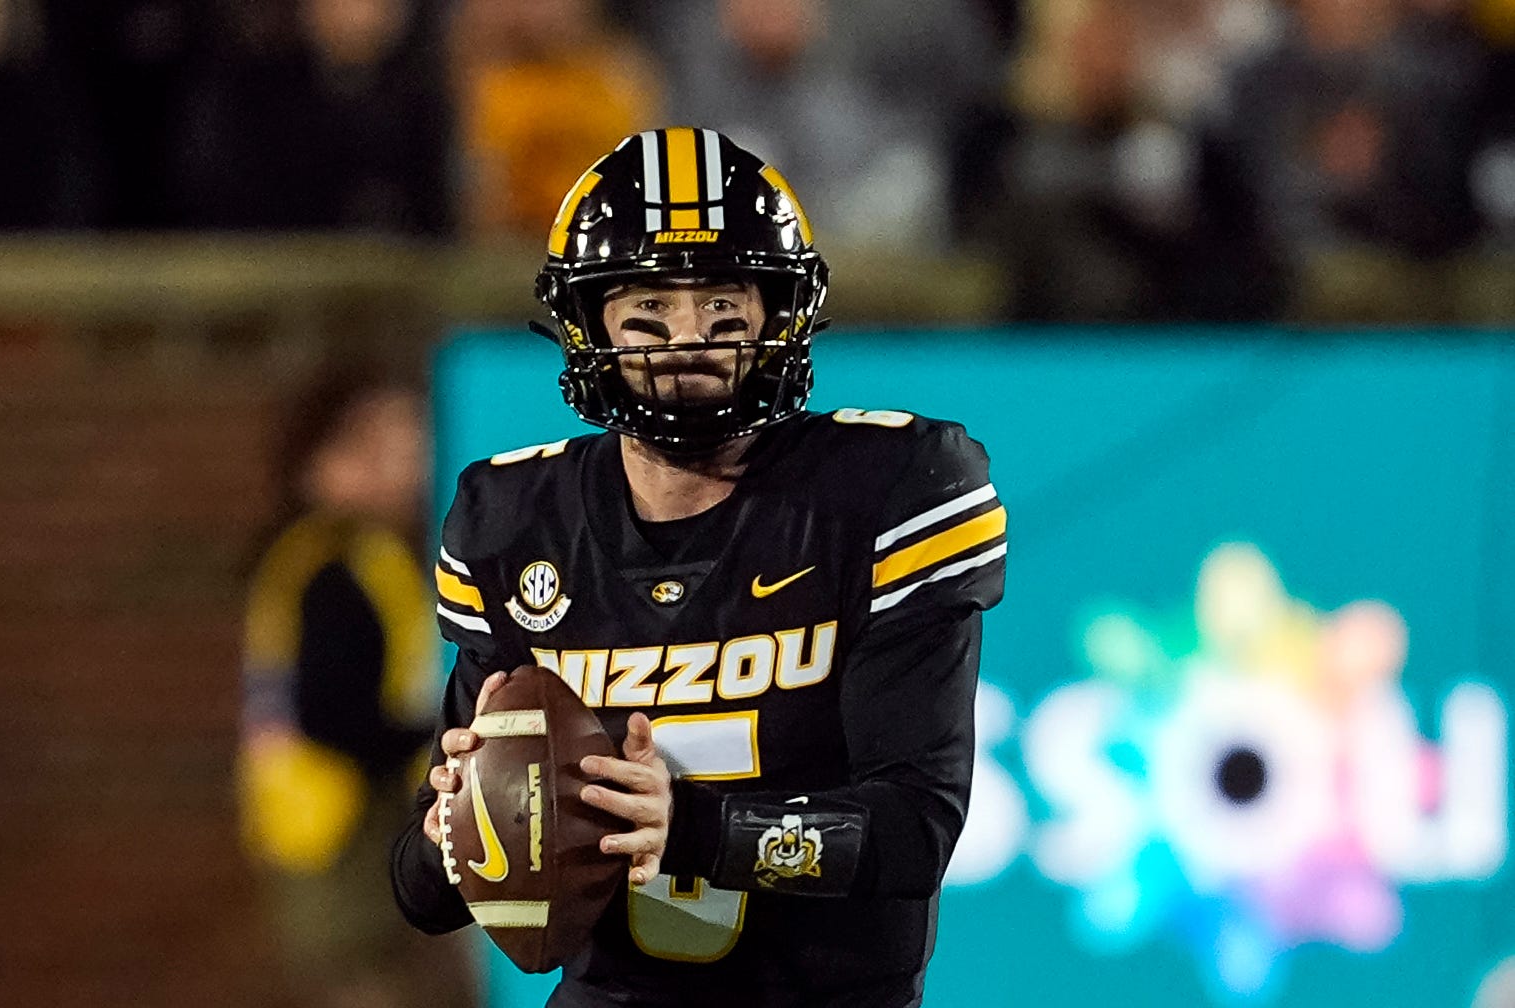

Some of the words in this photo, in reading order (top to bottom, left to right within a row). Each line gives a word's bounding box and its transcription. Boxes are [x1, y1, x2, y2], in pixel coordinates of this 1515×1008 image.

[654, 230, 719, 244] MIZZOU
[522, 564, 557, 607] SEC
[514, 608, 563, 630] GRADUATE
